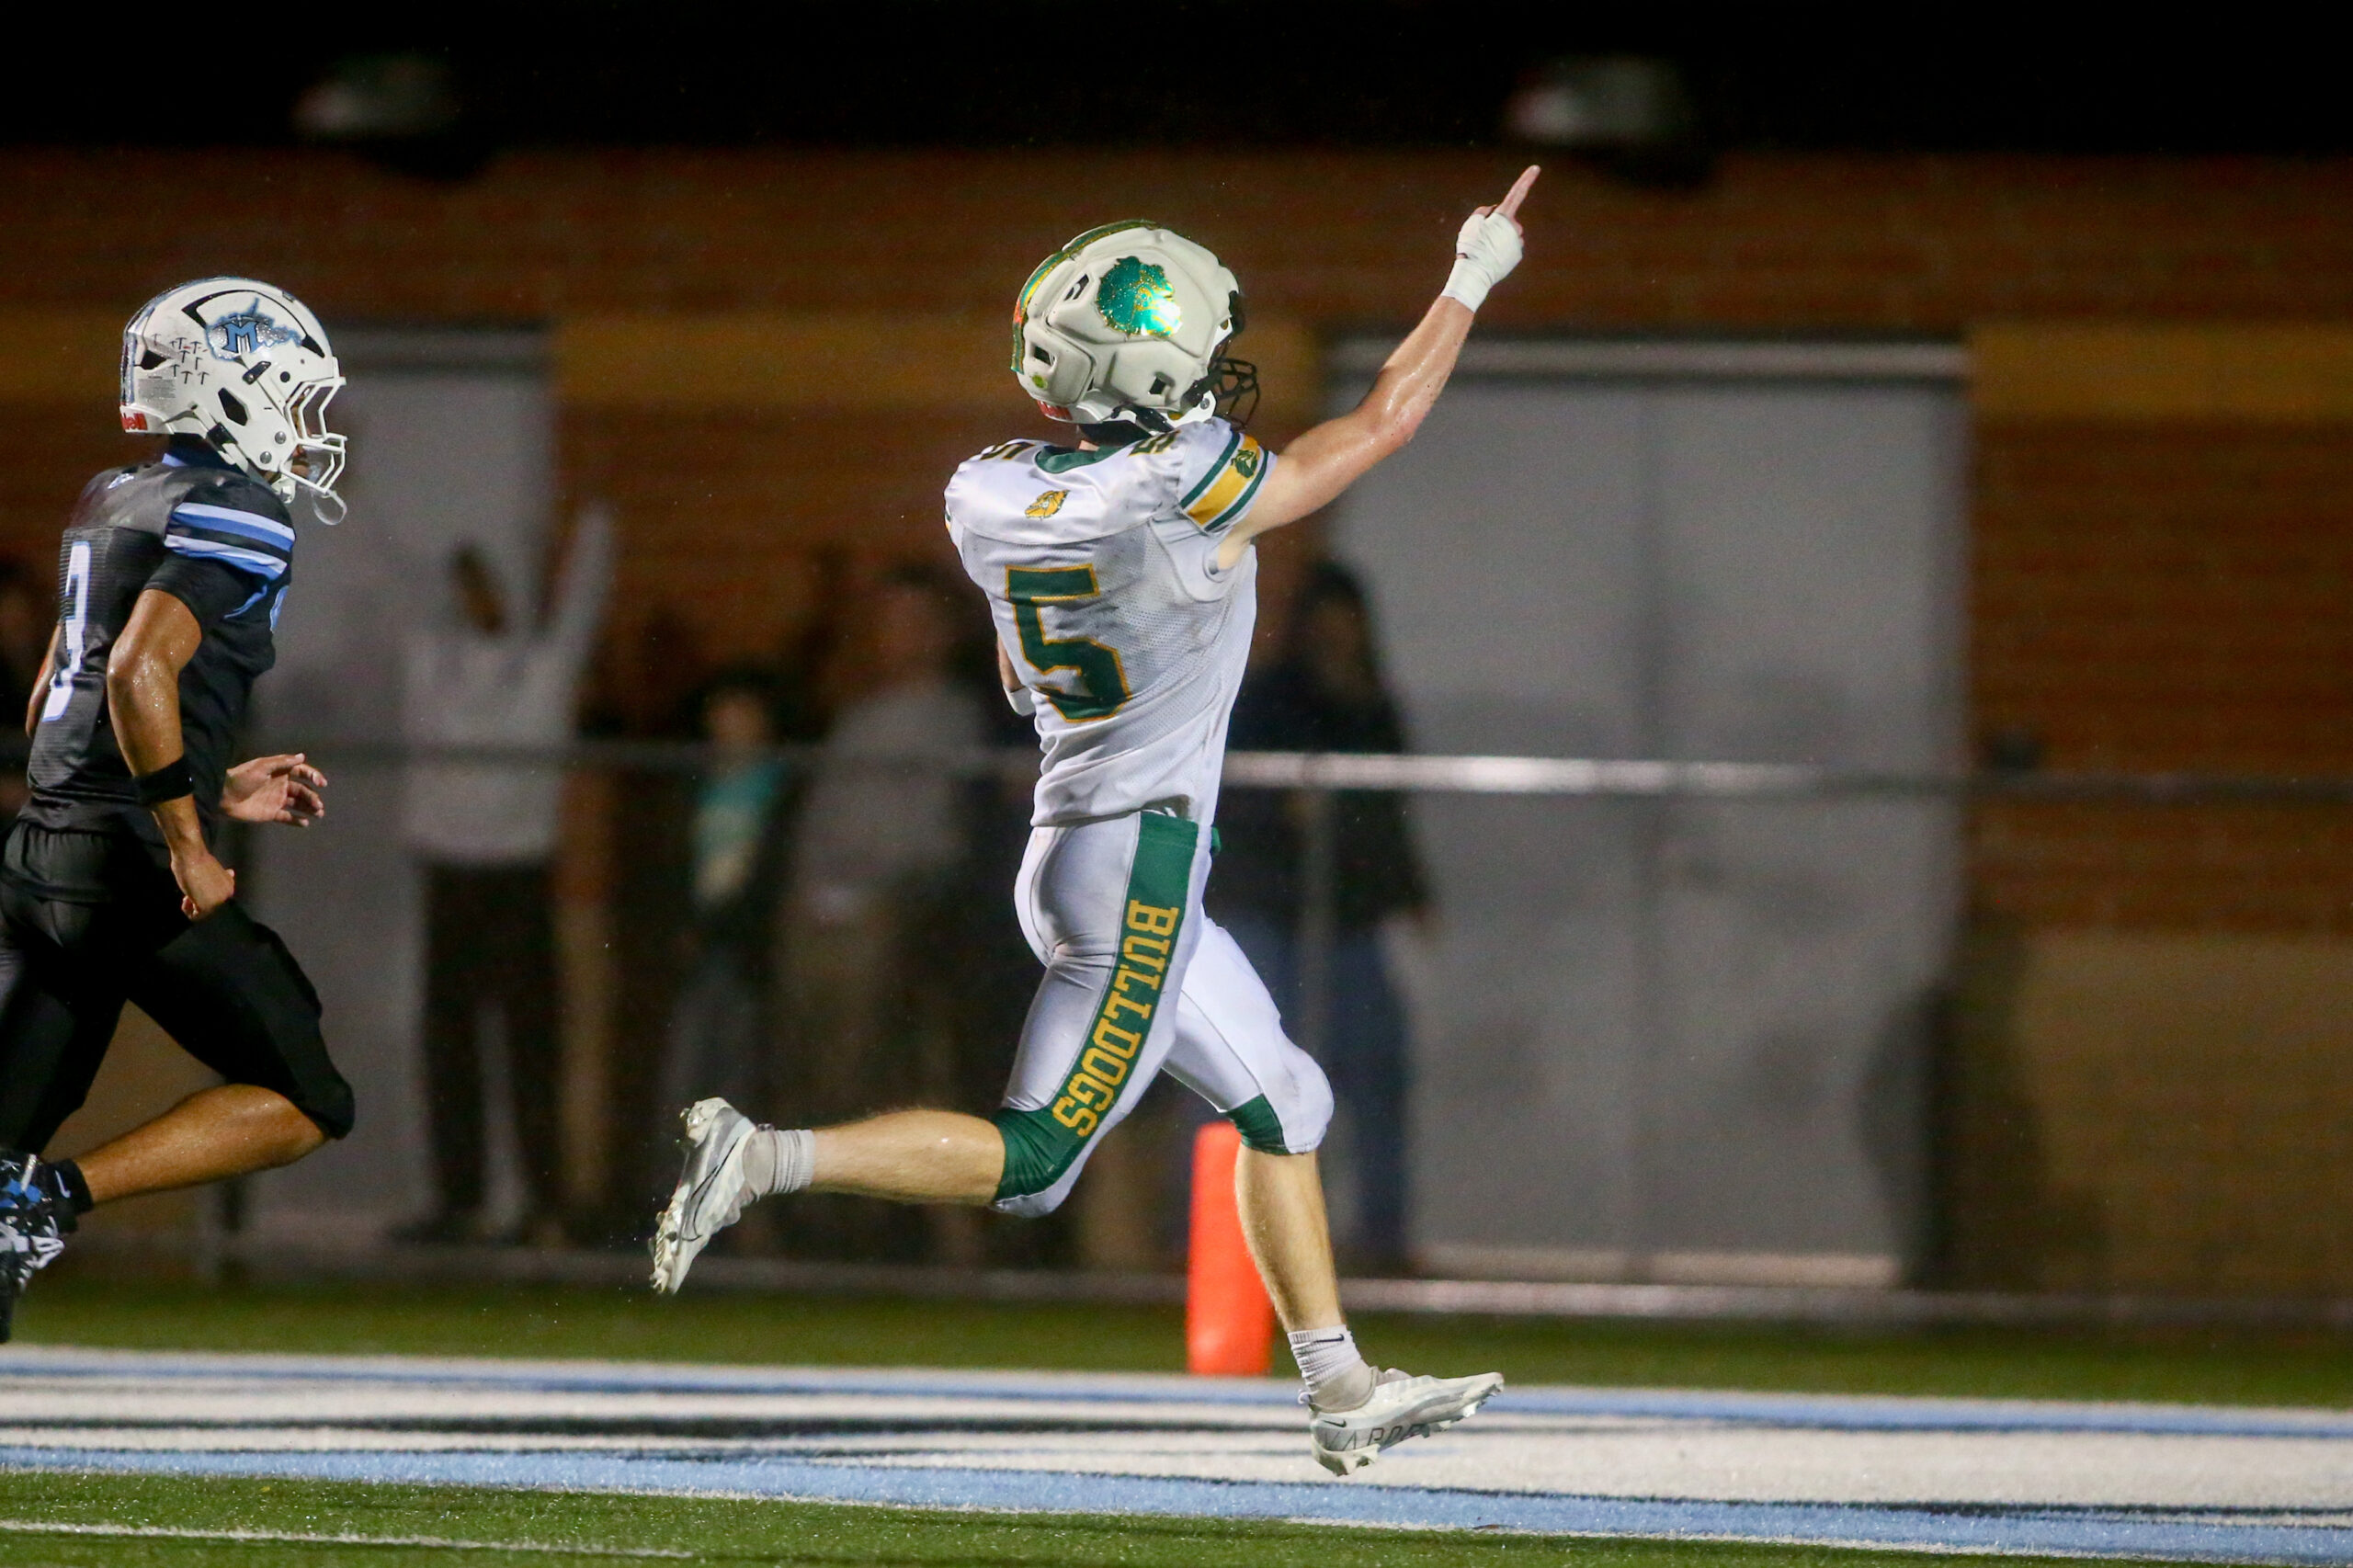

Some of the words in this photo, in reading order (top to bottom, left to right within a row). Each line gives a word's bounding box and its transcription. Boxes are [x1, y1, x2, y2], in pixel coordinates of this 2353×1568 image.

[222, 321, 258, 354] M
[1005, 563, 1132, 722] 5
[1051, 900, 1179, 1137] BULLDOGS
